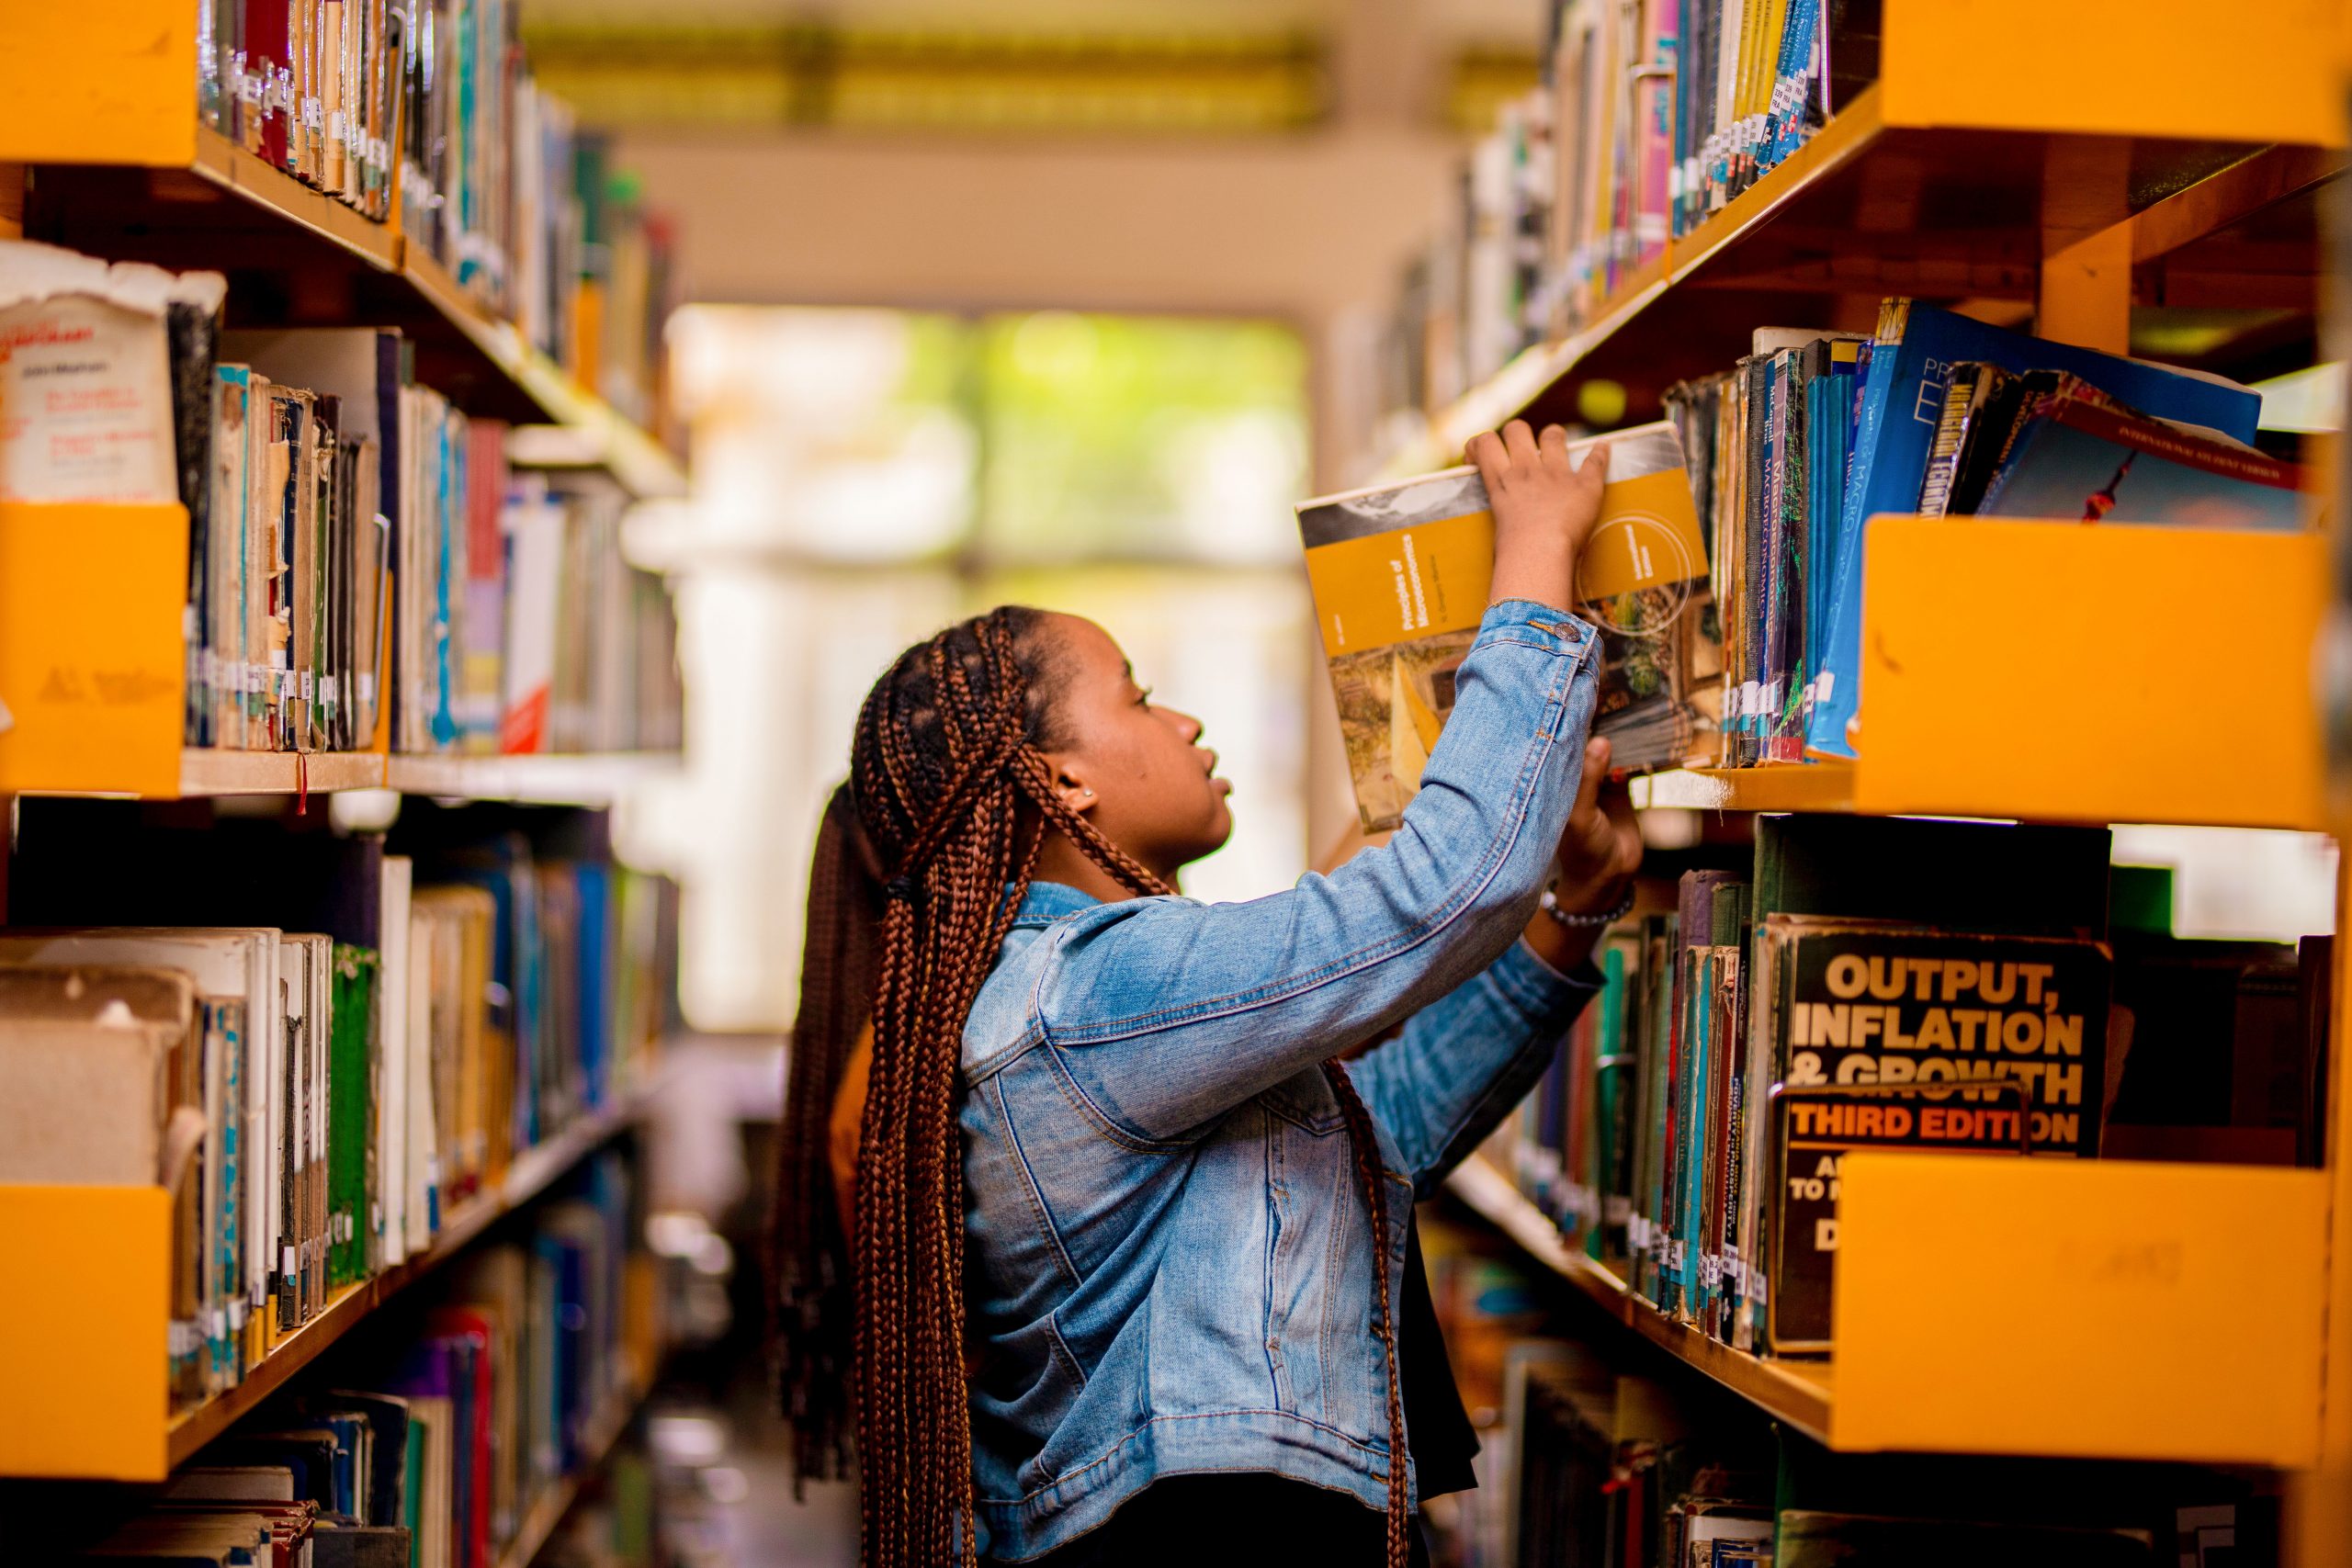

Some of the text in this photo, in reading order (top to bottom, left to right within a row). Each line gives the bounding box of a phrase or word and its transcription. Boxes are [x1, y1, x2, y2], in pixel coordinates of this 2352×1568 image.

[1933, 384, 1973, 458] MANAGERIAL
[1843, 465, 1867, 533] MACRO
[1402, 534, 1429, 626] Microeconomics
[1768, 459, 1781, 646] Macroeconomics
[1389, 558, 1414, 631] Principles of
[1825, 953, 2060, 1014] OUTPUT,
[1792, 1001, 2085, 1057] INFLATION
[1731, 1077, 1739, 1136] POVERTY
[1788, 1051, 2084, 1105] & GROWTH
[1790, 1102, 2080, 1144] THIRD EDITION
[1725, 1149, 1736, 1238] PROSPERITY?
[1788, 1177, 1826, 1201] TO
